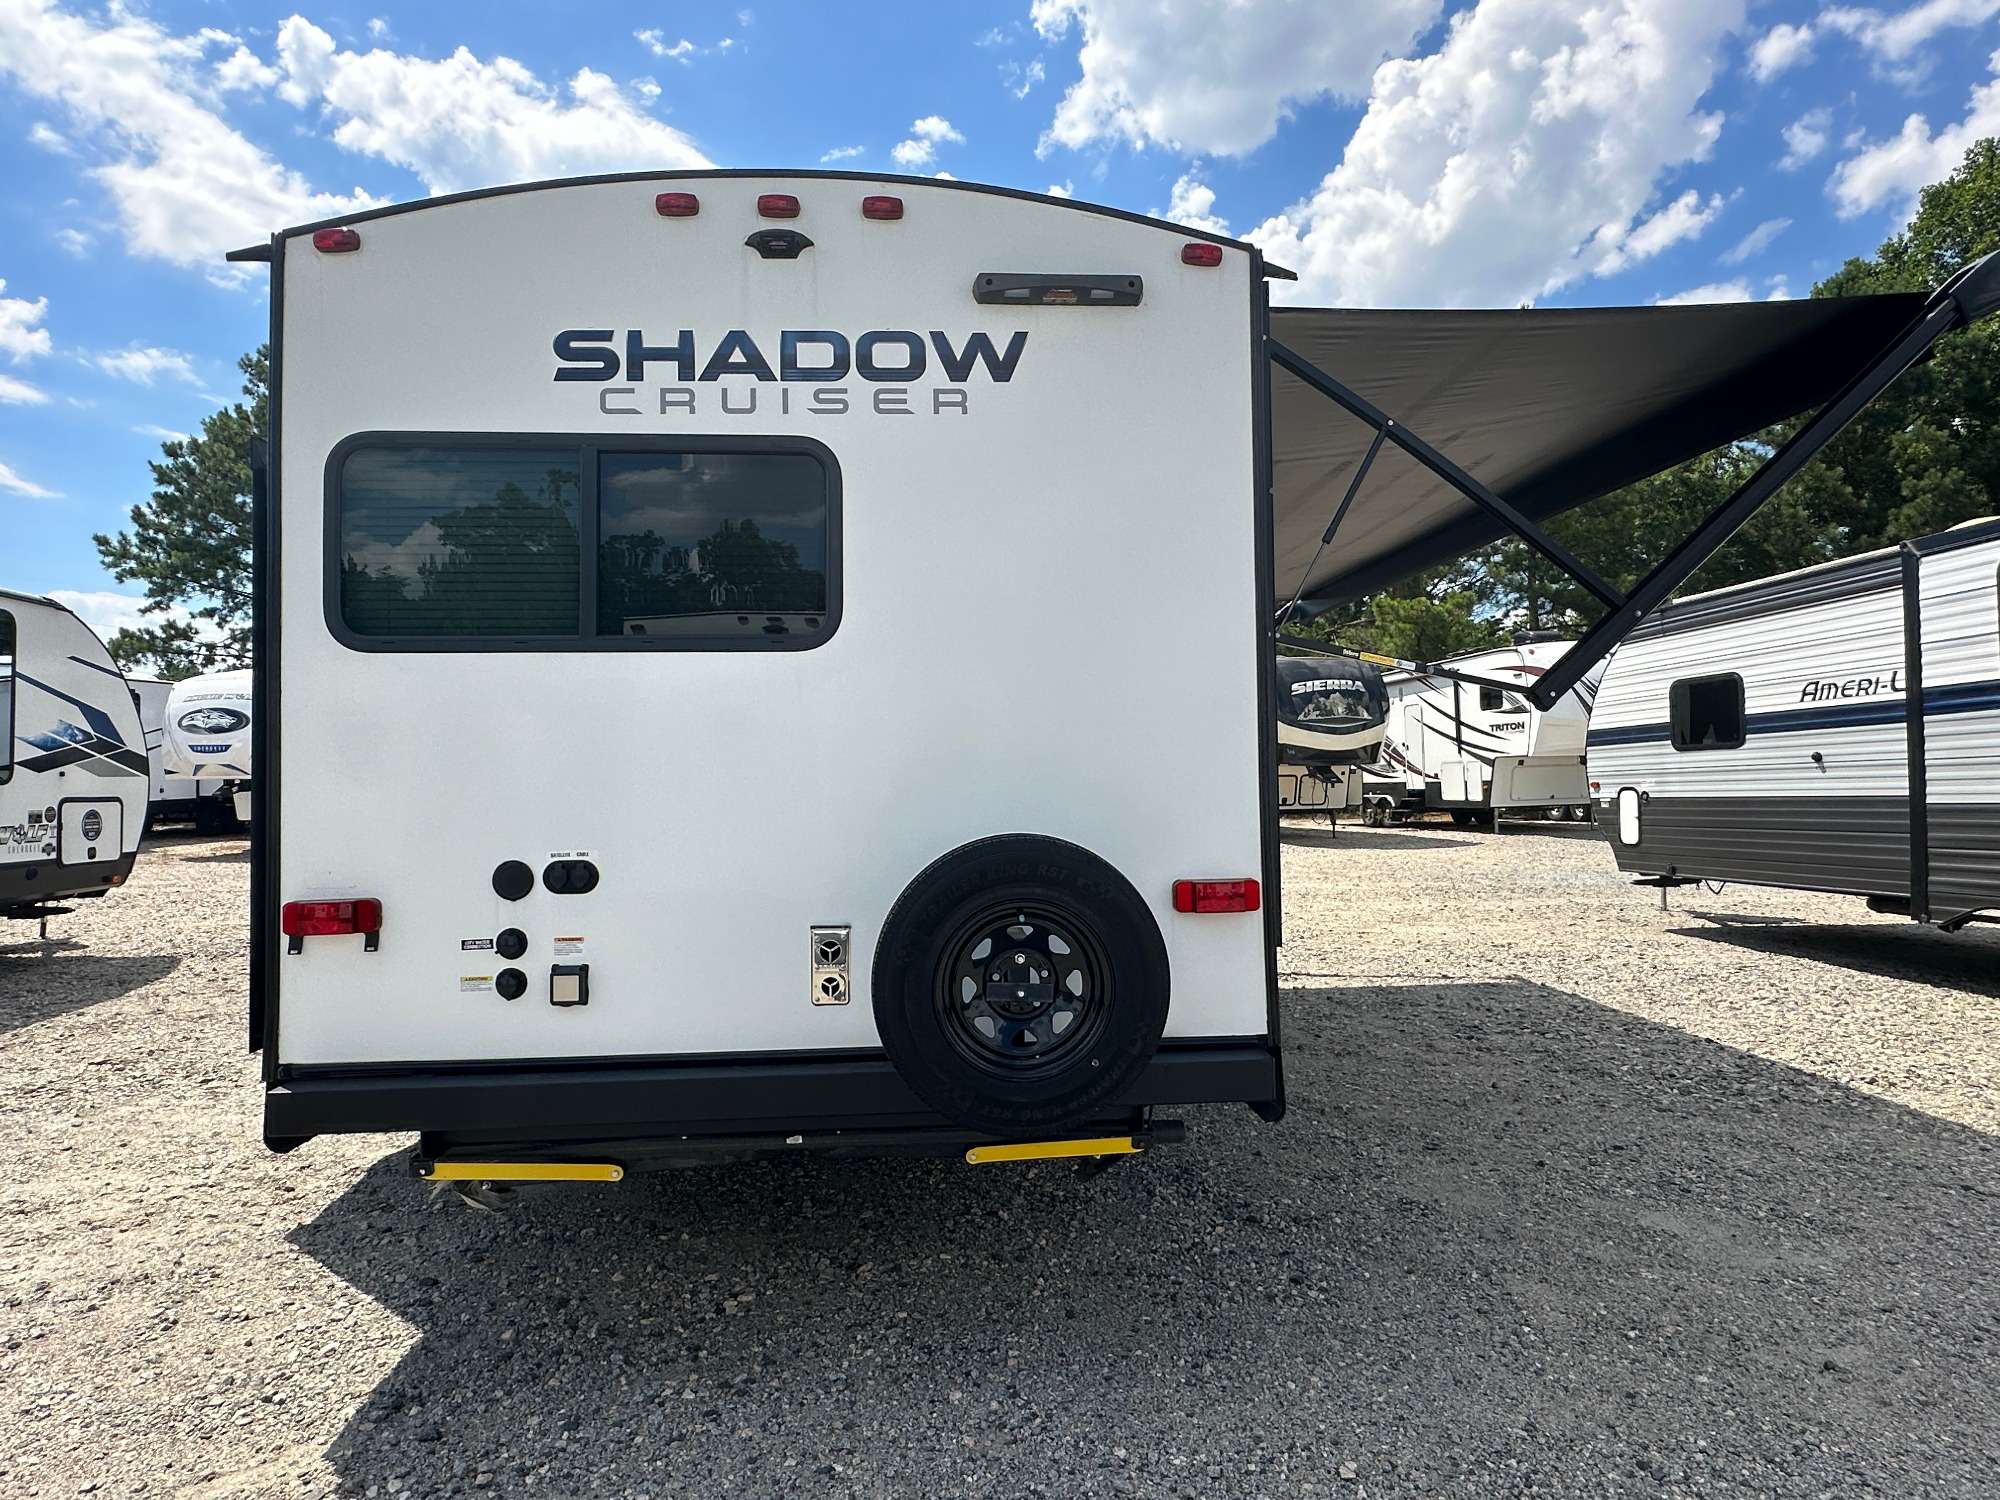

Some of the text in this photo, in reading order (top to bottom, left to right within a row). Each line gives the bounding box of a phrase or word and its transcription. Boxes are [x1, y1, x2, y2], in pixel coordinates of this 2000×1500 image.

[553, 329, 1029, 382] SHADOW
[599, 388, 969, 415] CRUISER
[1290, 679, 1367, 696] SIERRA
[1489, 721, 1525, 732] TRITON
